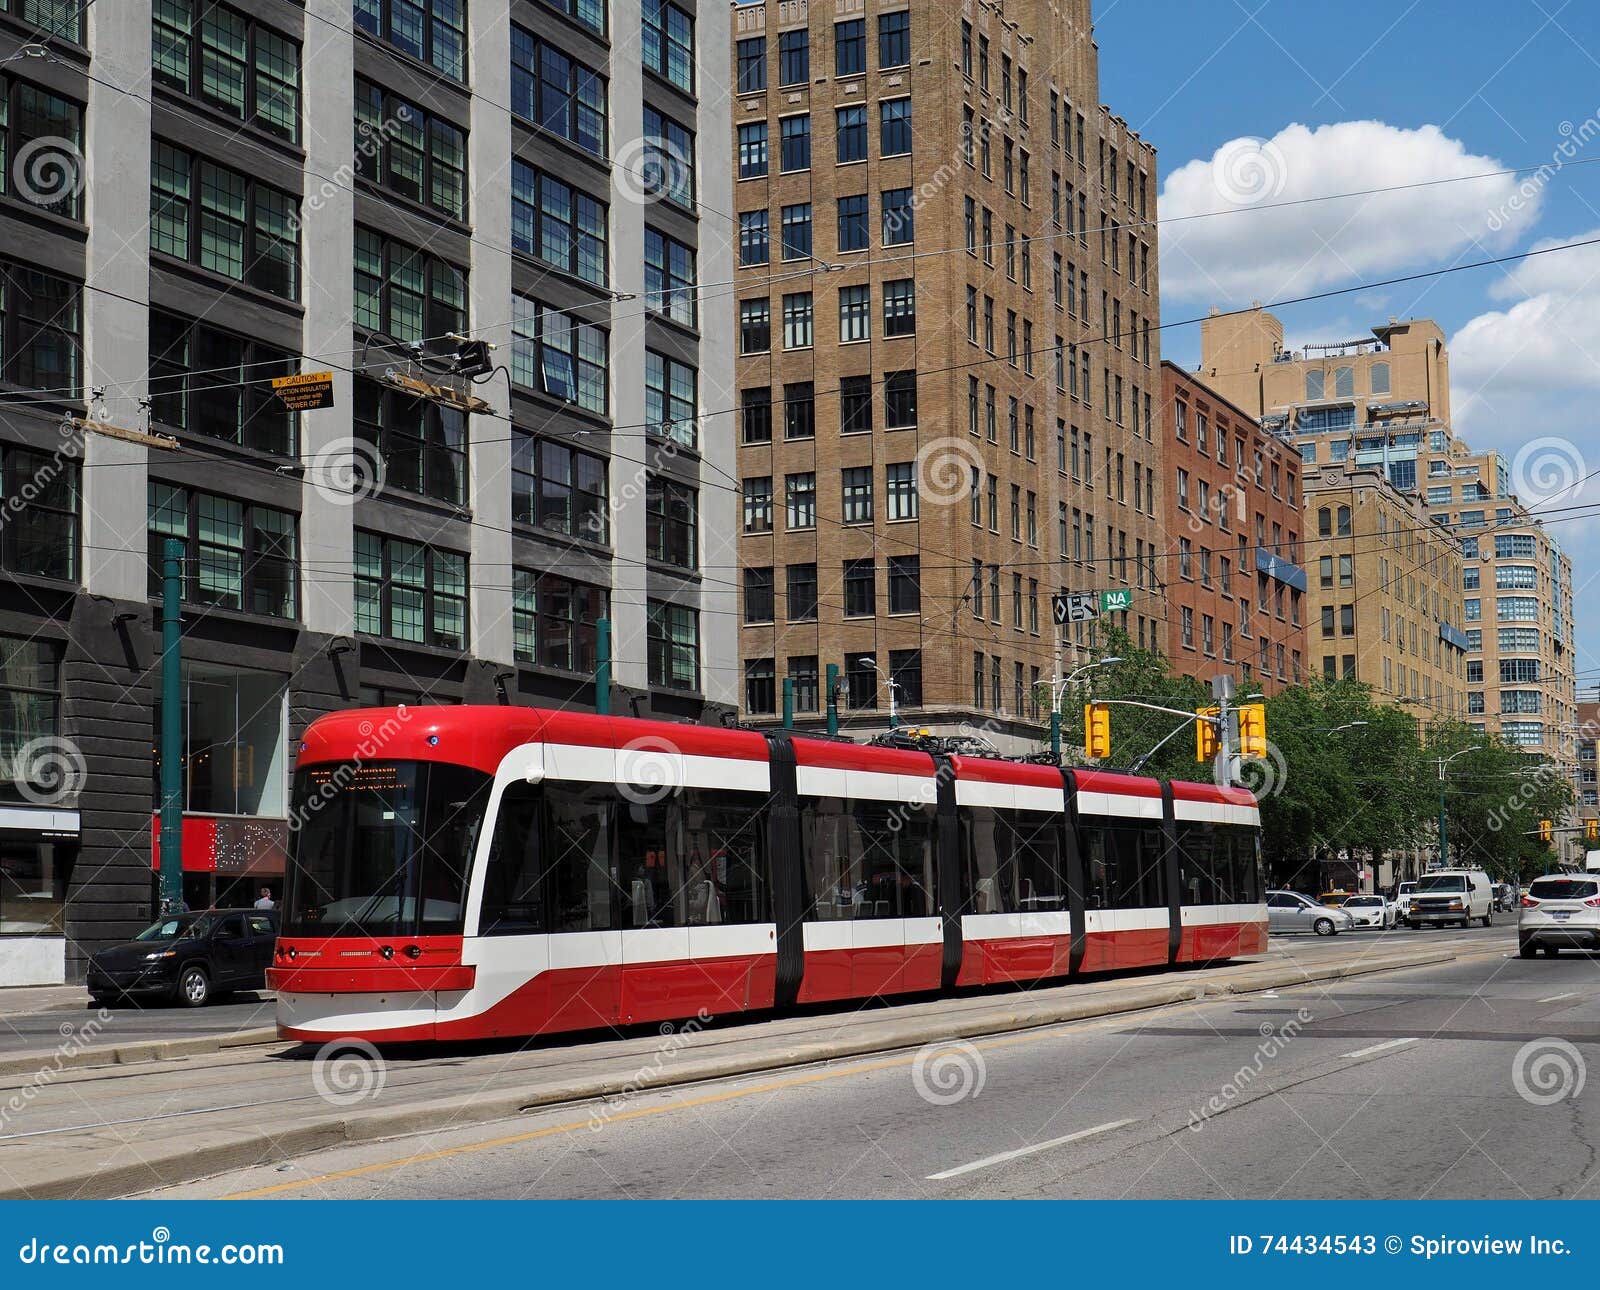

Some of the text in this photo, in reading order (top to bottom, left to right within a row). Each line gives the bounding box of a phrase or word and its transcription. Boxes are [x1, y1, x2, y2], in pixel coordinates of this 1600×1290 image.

[286, 374, 318, 385] CAUTION
[286, 399, 321, 410] POWER OFF
